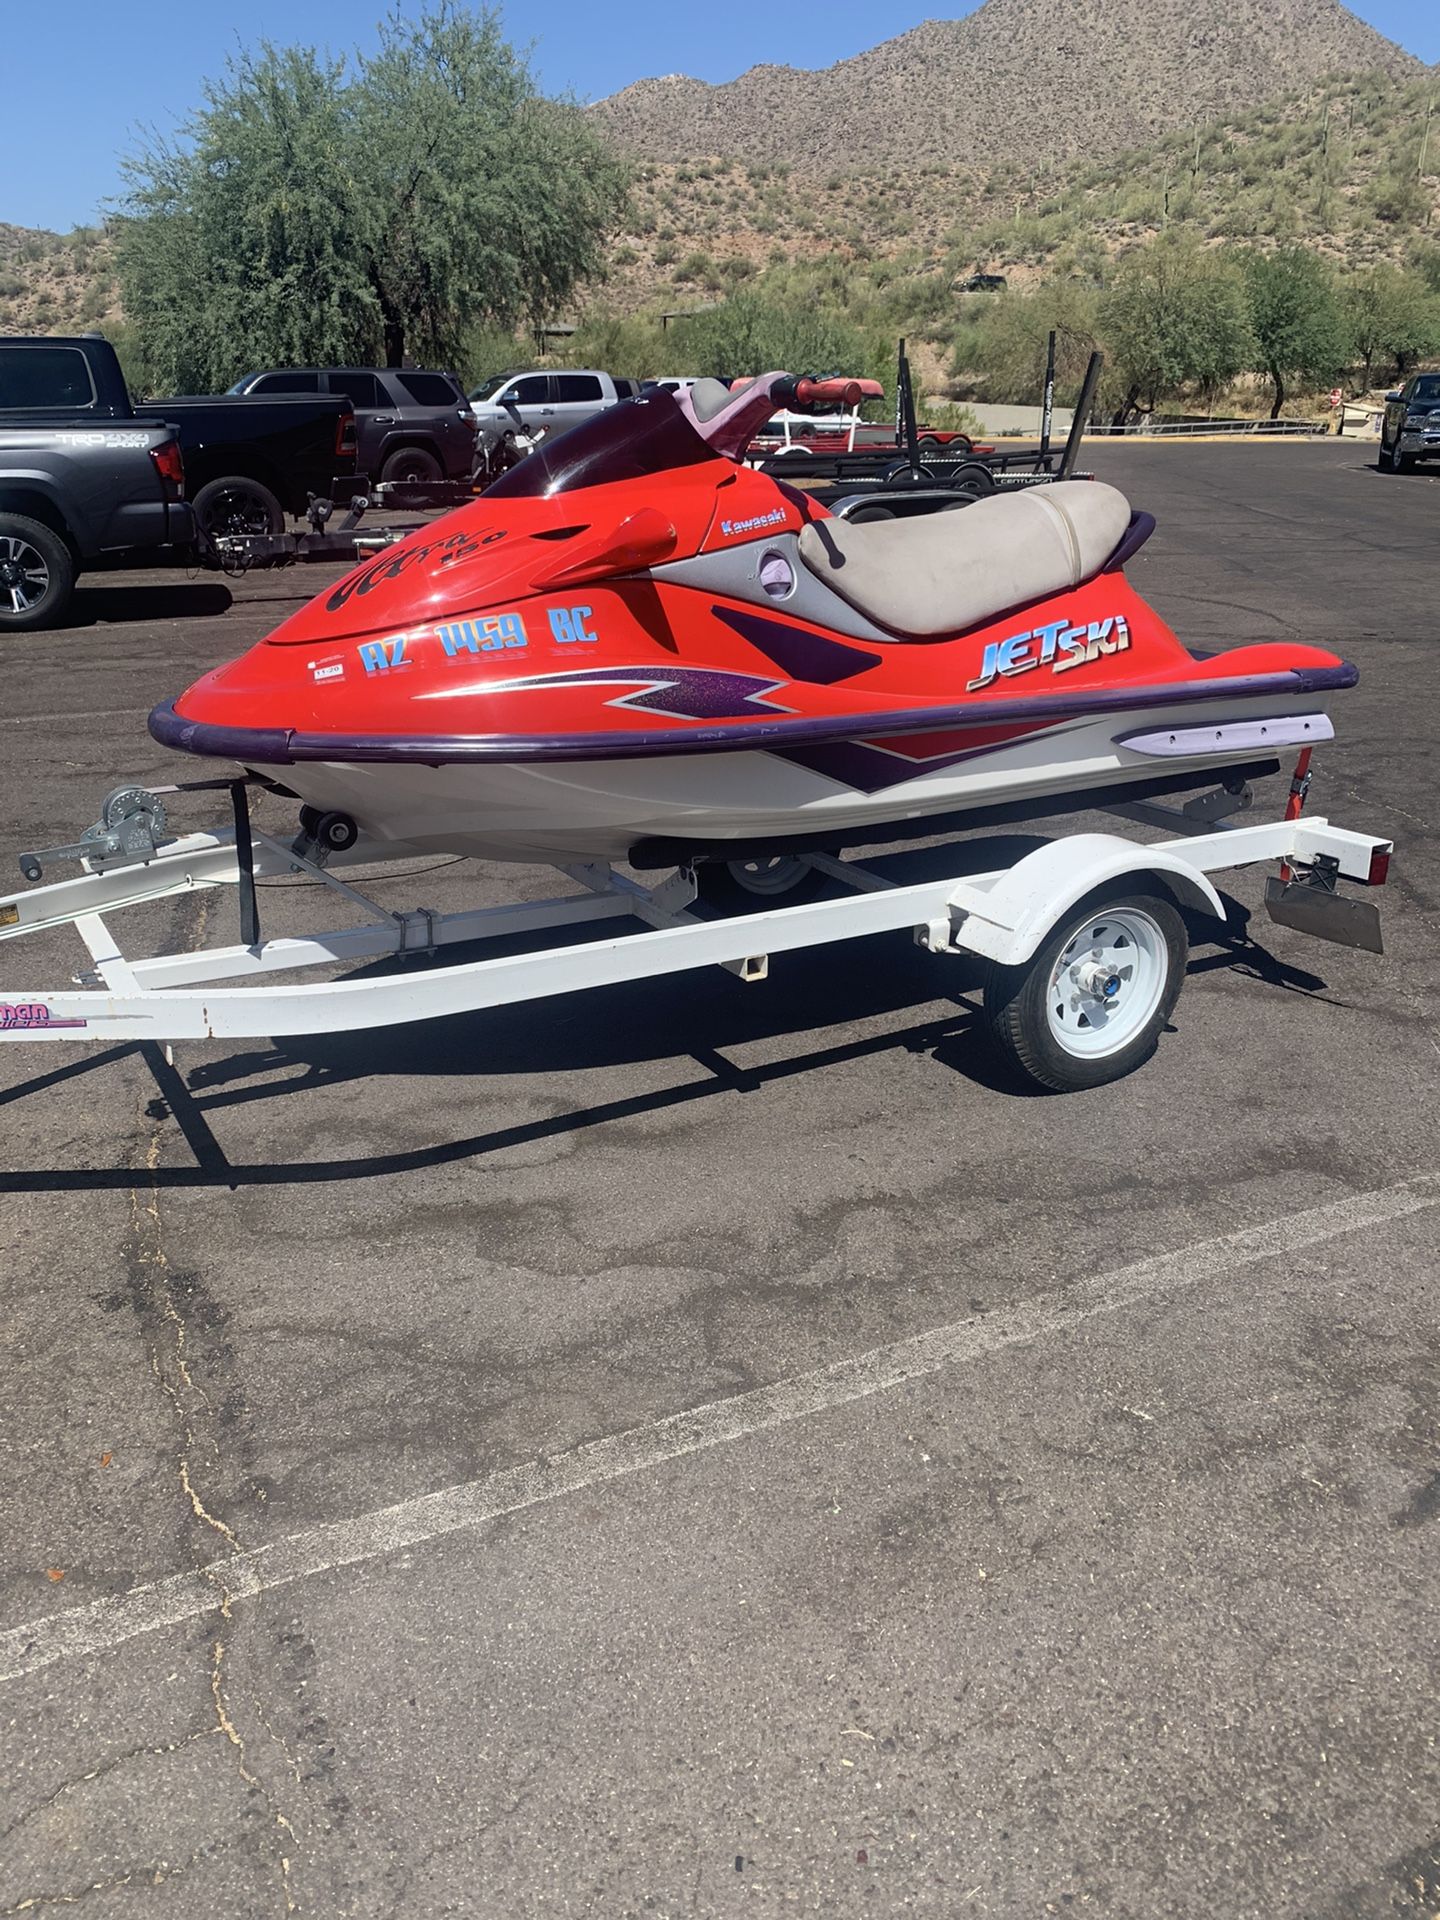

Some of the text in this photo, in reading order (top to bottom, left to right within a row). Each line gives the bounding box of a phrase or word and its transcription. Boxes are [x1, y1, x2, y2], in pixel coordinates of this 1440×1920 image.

[55, 433, 105, 447] TRD
[721, 507, 787, 536] Kawasaki
[357, 605, 599, 673] AZ 1459 BC
